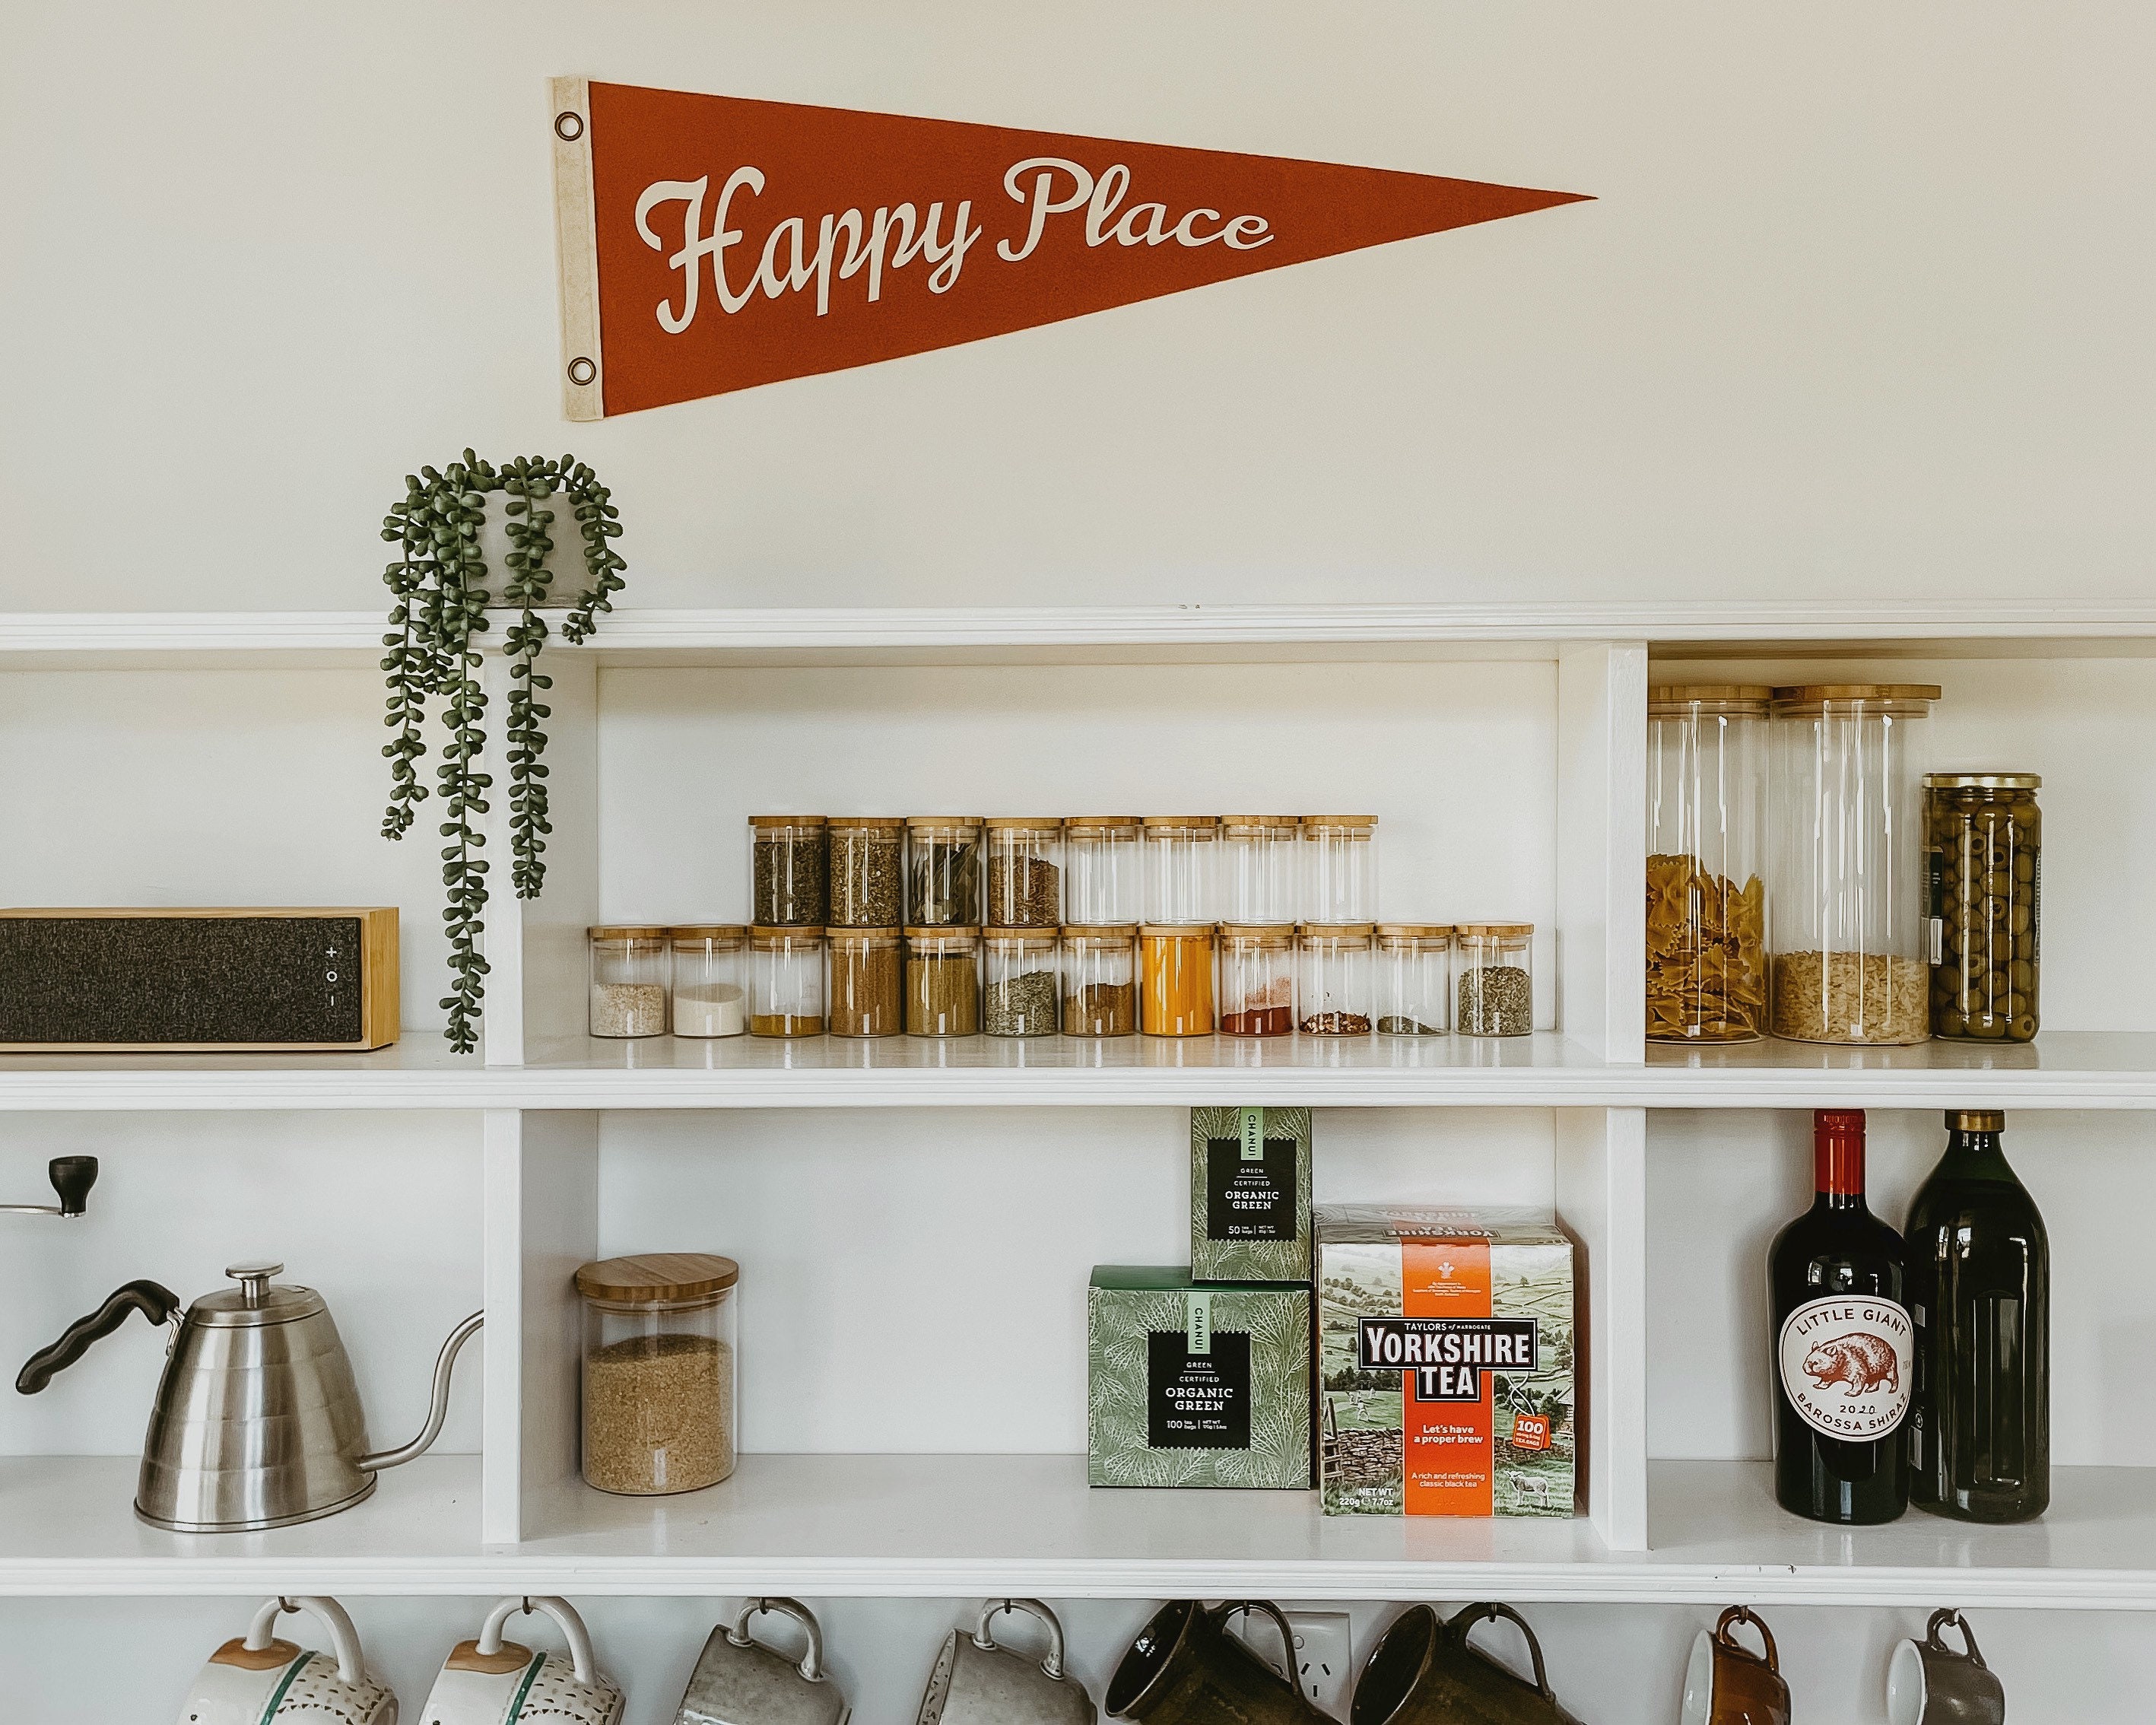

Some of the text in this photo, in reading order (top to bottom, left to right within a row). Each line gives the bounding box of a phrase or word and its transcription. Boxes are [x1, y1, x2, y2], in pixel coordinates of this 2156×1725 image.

[635, 157, 1275, 334] Happy Place
[1247, 1114, 1256, 1156] CHANUI
[1225, 1190, 1279, 1200] ORGANIC
[1232, 1201, 1272, 1210] GREEN
[1227, 1225, 1240, 1234] 50
[1404, 1323, 1447, 1331] TAYLORS
[1796, 1307, 1907, 1336] LITTLE GIANT
[1194, 1307, 1203, 1350] CHANUI
[1367, 1327, 1529, 1364] YORKSHIRE
[1421, 1366, 1475, 1395] TEA
[1165, 1387, 1234, 1398] ORGANIC
[1174, 1400, 1224, 1411] GREEN
[1840, 1405, 1877, 1414] 2020
[1797, 1392, 1907, 1431] BAROSSA SHIRAZ
[1166, 1420, 1183, 1429] 100
[1423, 1424, 1475, 1434] Let's have
[1516, 1420, 1544, 1434] 100
[1421, 1435, 1456, 1445] proper
[1457, 1434, 1484, 1444] brew
[1448, 1472, 1486, 1482] refreshing
[1358, 1488, 1394, 1496] NET WT
[1339, 1497, 1395, 1507] 220g 7.7oz
